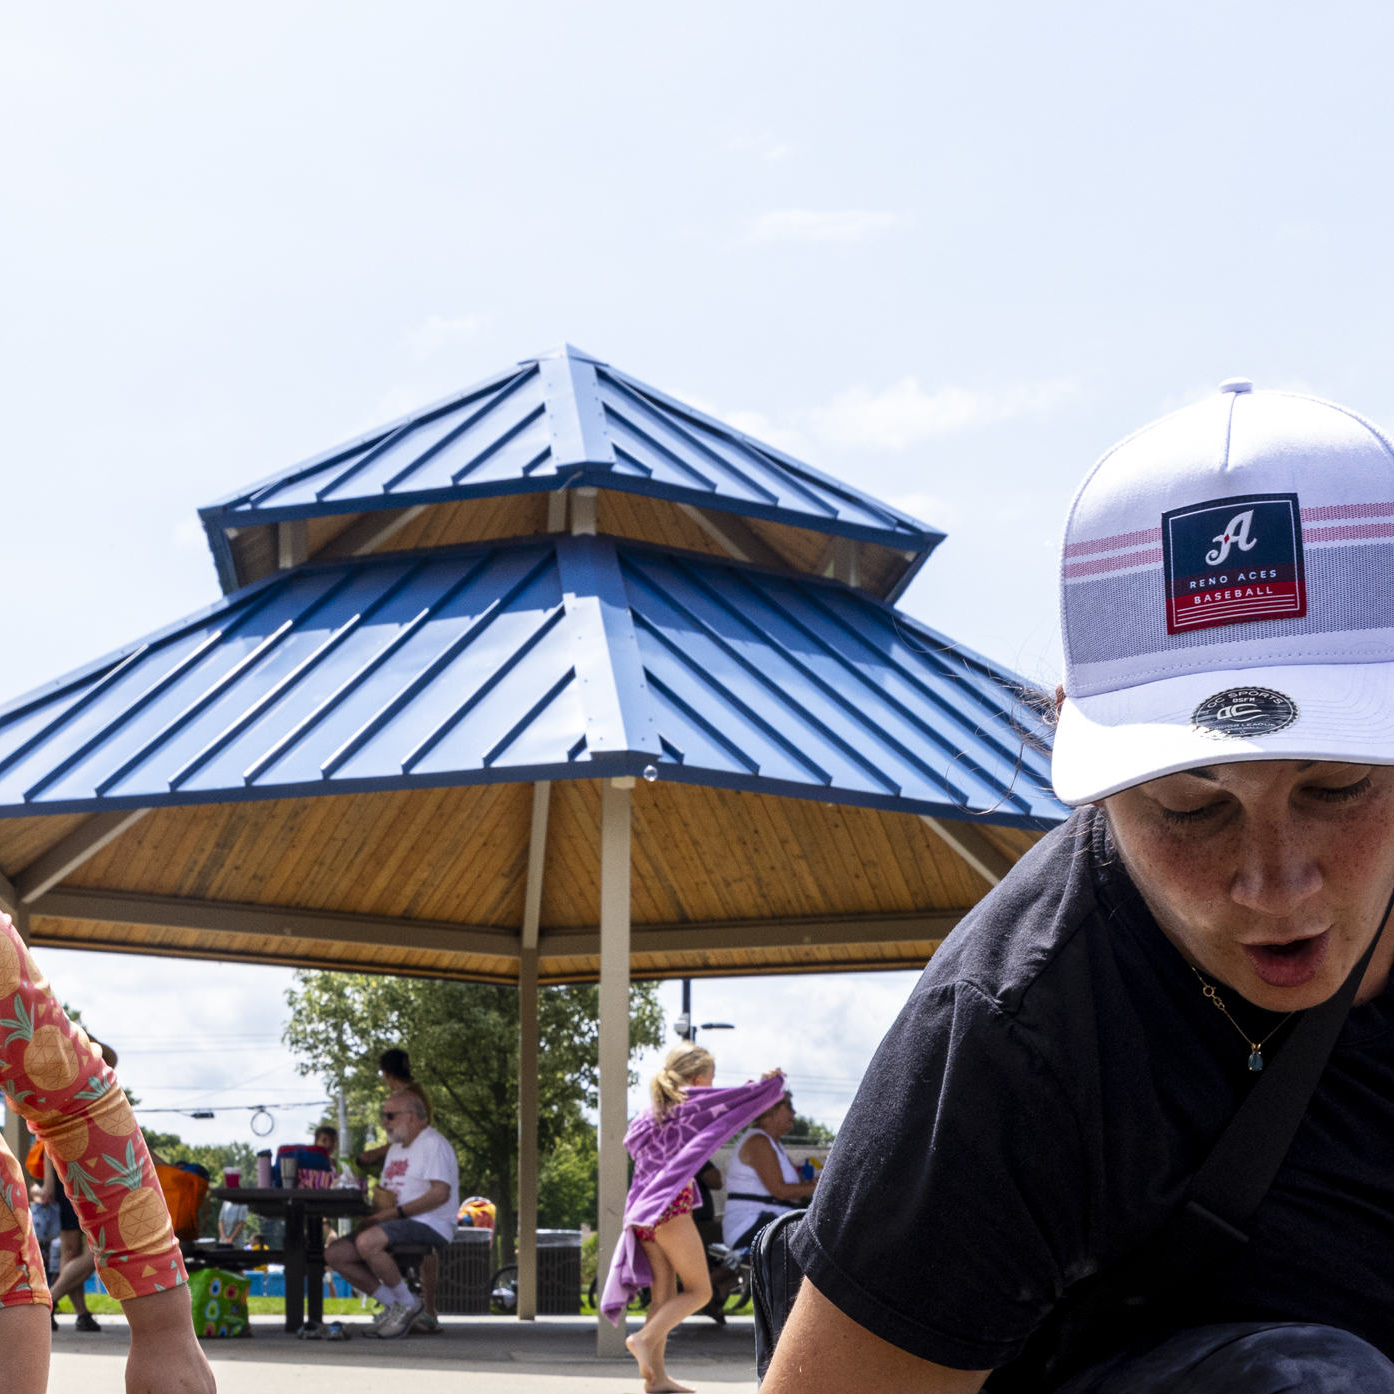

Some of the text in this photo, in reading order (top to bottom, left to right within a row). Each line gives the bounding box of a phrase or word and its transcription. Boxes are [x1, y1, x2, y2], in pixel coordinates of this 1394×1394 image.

[1205, 509, 1258, 566] A
[1189, 569, 1278, 589] RENO ACES
[1193, 586, 1274, 605] BASEBALL
[1207, 690, 1285, 709] OC SPORTS
